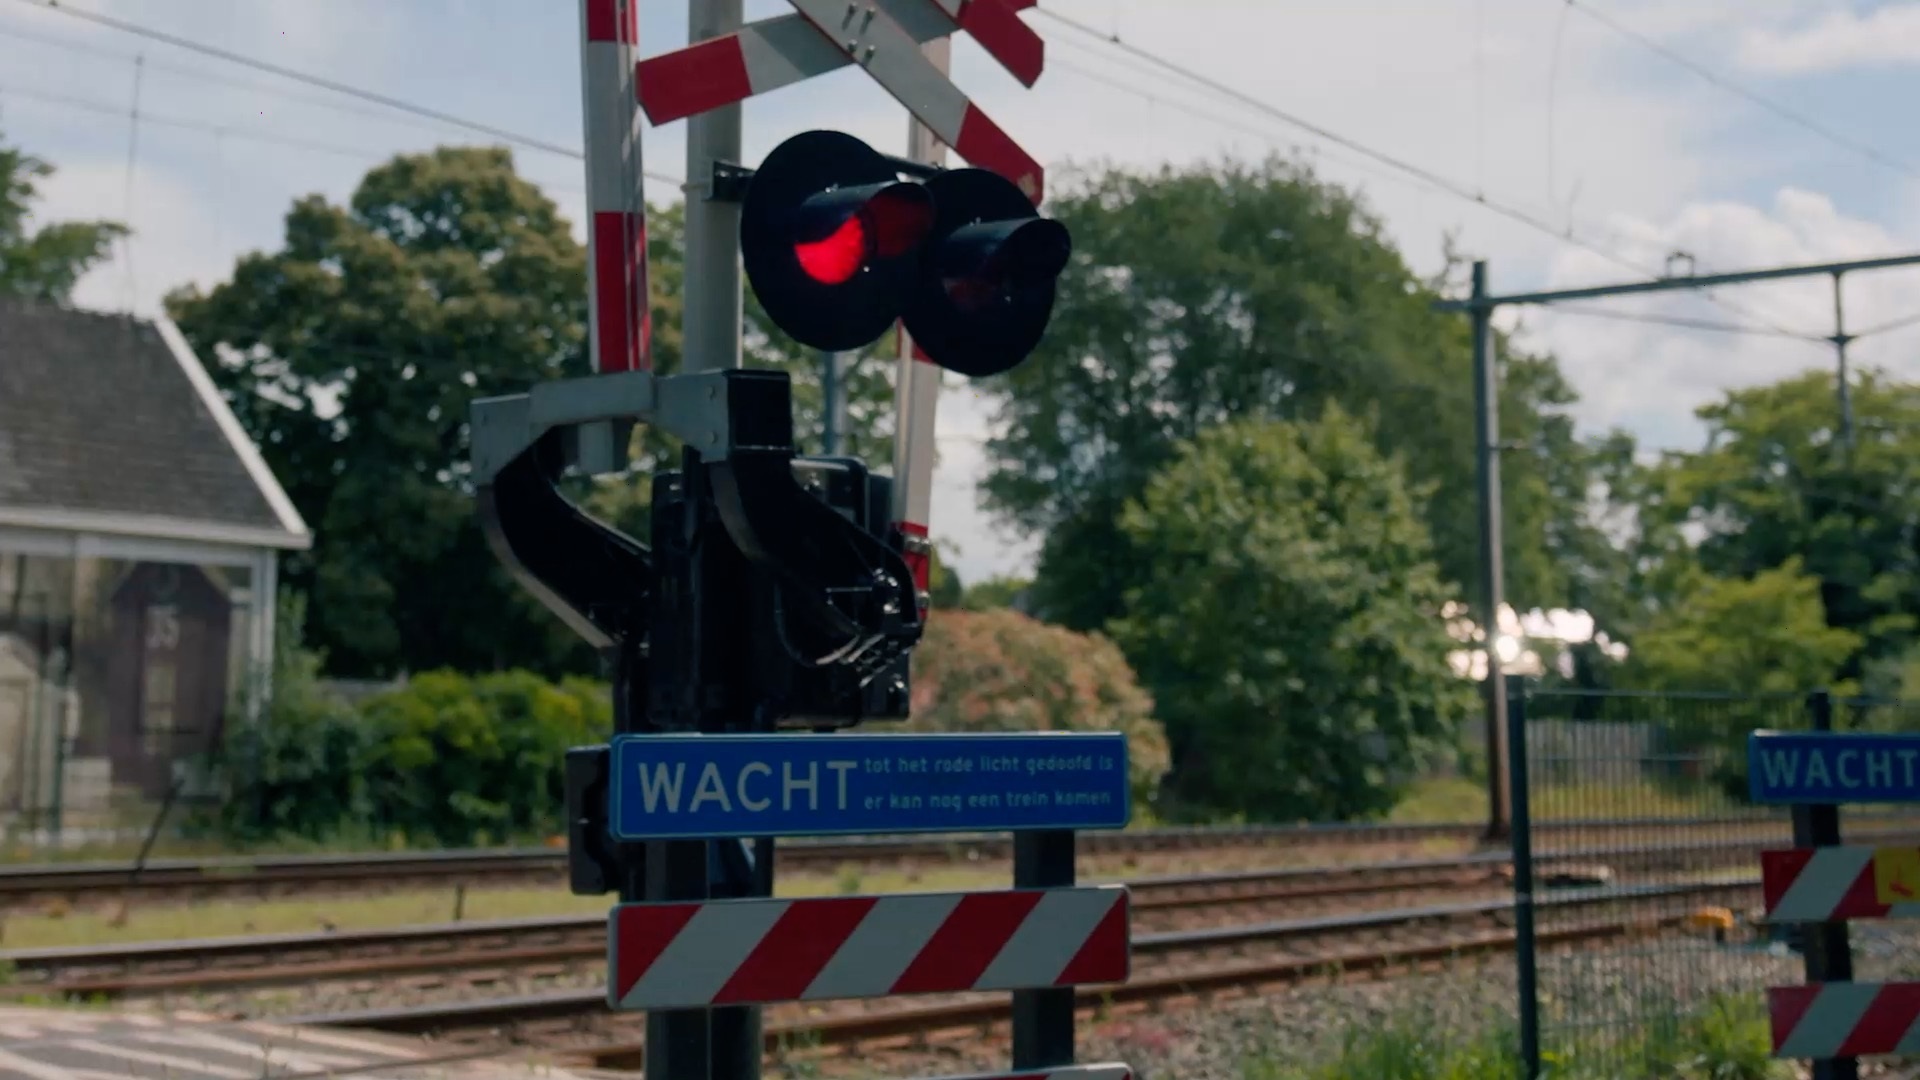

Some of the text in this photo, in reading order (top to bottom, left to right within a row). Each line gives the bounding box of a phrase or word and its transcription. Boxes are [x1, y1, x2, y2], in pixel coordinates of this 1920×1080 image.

[864, 754, 1114, 776] tot het rode licht gedoofd is
[1761, 749, 1918, 788] WACHT
[638, 761, 858, 813] WACHT
[864, 790, 1111, 813] er kan nog een trein komen
